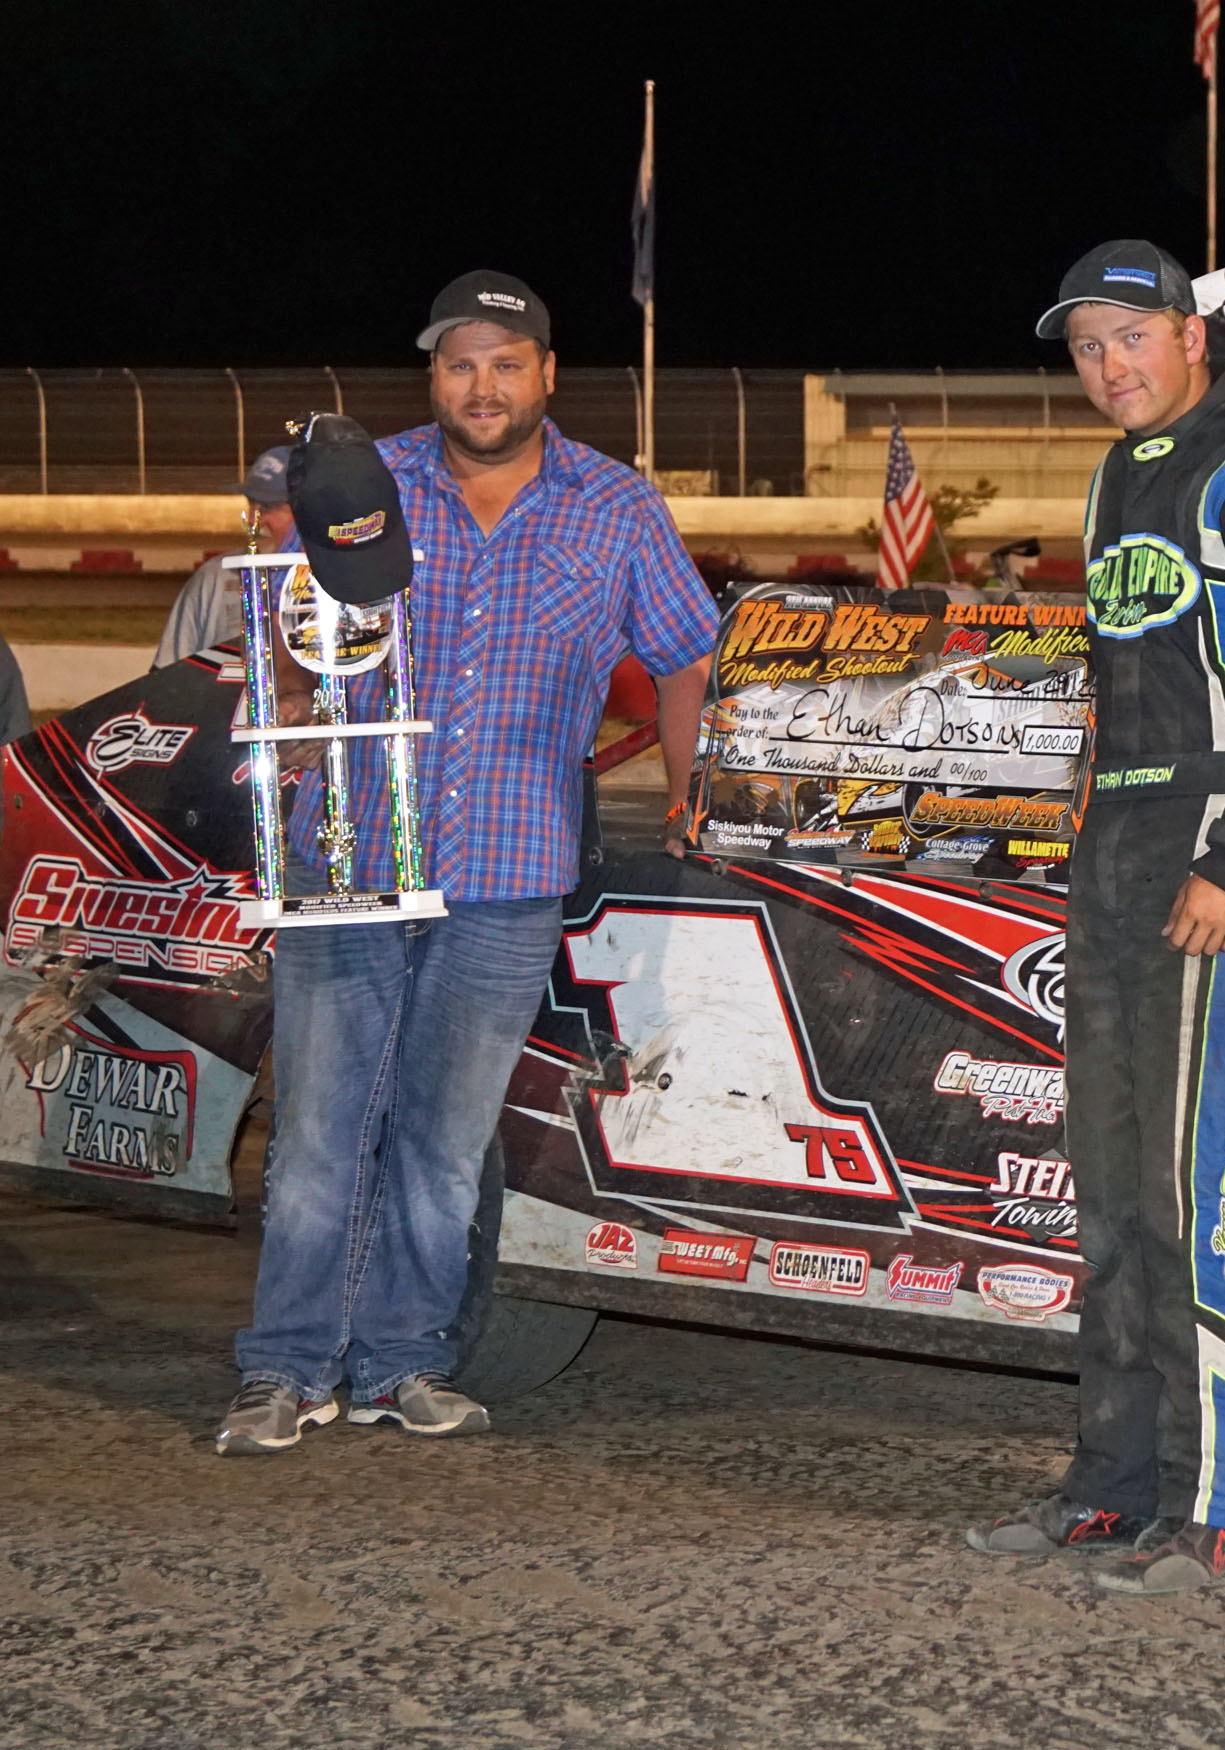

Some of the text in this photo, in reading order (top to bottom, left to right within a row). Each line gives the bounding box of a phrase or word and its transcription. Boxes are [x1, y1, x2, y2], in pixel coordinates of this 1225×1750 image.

[943, 604, 1030, 626] FEATURE
[720, 601, 931, 663] WILD WEST
[720, 653, 922, 690] Modified Shootout
[971, 663, 1034, 694] June
[940, 679, 967, 697] Date:
[730, 704, 779, 722] Pay to the
[786, 688, 891, 742] Ethan
[96, 724, 189, 761] ELITE
[726, 726, 769, 739] order of:
[1026, 733, 1080, 752] 1,000.00
[130, 748, 174, 759] SIGNS
[725, 745, 988, 782] One Thousand Dollars and 00/100
[1096, 764, 1176, 792] ETHAN DOTSON
[911, 792, 1069, 831] SPEEDWEEK
[707, 819, 785, 838] Siskiyou Motor
[717, 833, 773, 850] Speedway
[925, 838, 990, 852] Cottage Grove
[1007, 839, 1070, 858] WILLAMETTE
[26, 1044, 178, 1117] DEWAR
[937, 1053, 1065, 1100] Greenwa
[63, 1103, 179, 1177] FARMS
[991, 1197, 1078, 1236] Towin
[588, 1224, 635, 1253] JAZ
[671, 1240, 712, 1260] SWEET
[712, 1243, 739, 1267] Mfg.
[775, 1251, 863, 1284] SCHOENFELD
[889, 1257, 959, 1293] SUMMIT
[982, 1271, 1037, 1285] PERFORMANCE
[1039, 1278, 1070, 1288] BODIES
